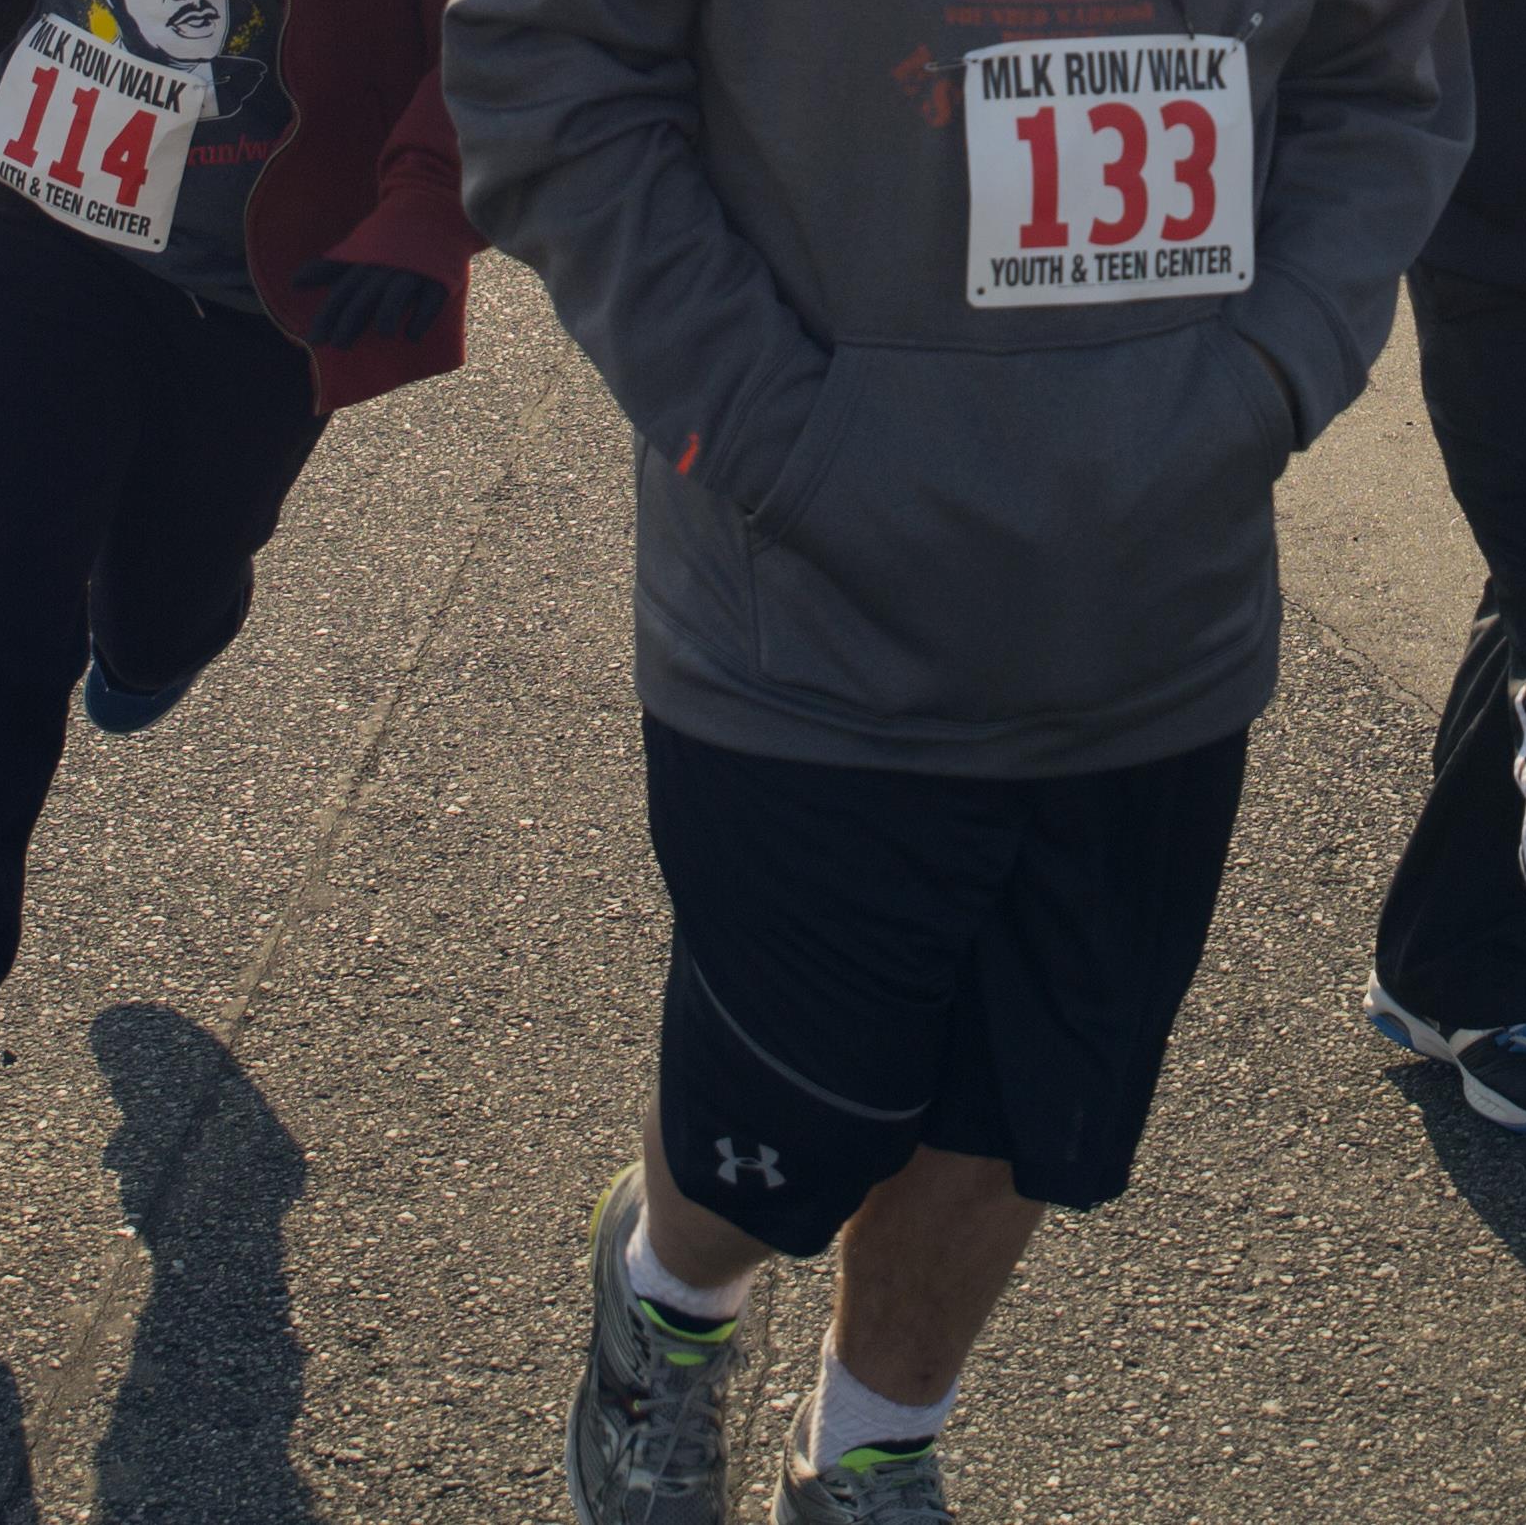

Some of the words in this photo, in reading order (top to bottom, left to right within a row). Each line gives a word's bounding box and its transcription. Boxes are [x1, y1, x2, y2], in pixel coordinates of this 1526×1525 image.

[28, 20, 71, 66] MLK
[70, 38, 187, 114] RUN/WALK
[982, 53, 1055, 100] MLK
[1064, 49, 1227, 95] RUN/WALK
[3, 65, 159, 208] 114
[187, 132, 268, 166] run/w
[29, 173, 43, 197] &
[44, 180, 83, 217] TEEN
[85, 198, 152, 238] CENTER
[1016, 99, 1218, 249] 133
[990, 253, 1063, 286] YOUTH
[1070, 253, 1088, 283] &
[1093, 250, 1148, 282] TEEN
[1155, 244, 1232, 277] CENTER
